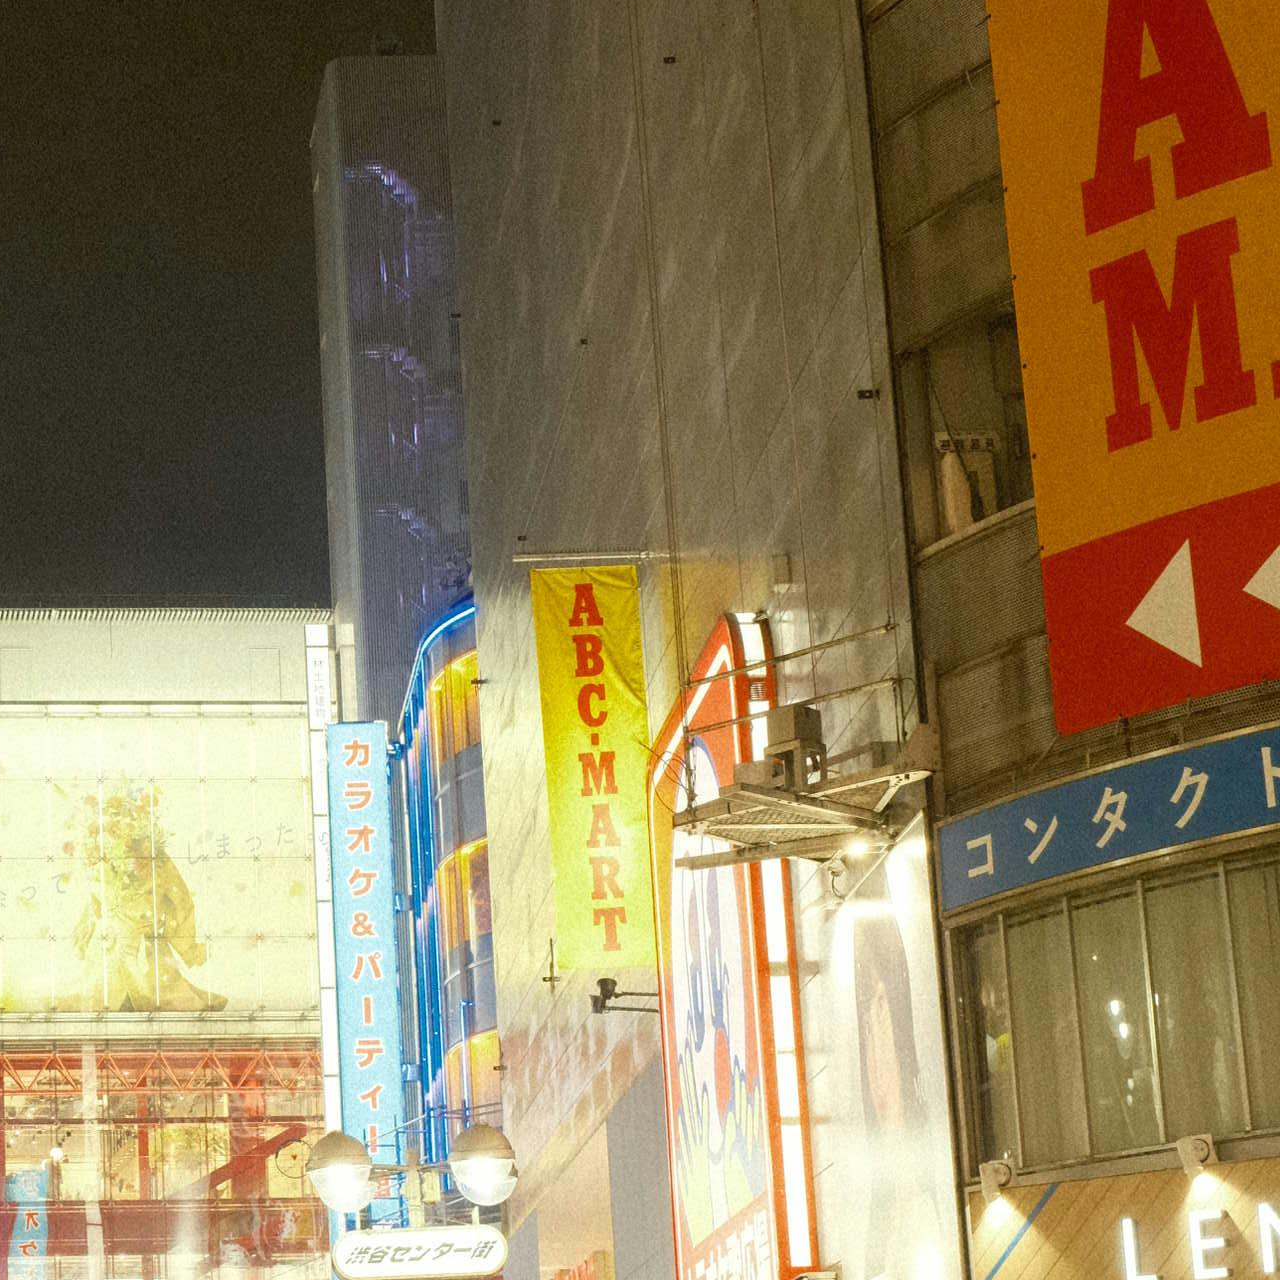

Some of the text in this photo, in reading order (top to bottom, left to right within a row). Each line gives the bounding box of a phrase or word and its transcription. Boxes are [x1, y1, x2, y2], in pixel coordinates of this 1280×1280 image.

[346, 1241, 495, 1263] 渋谷センター街
